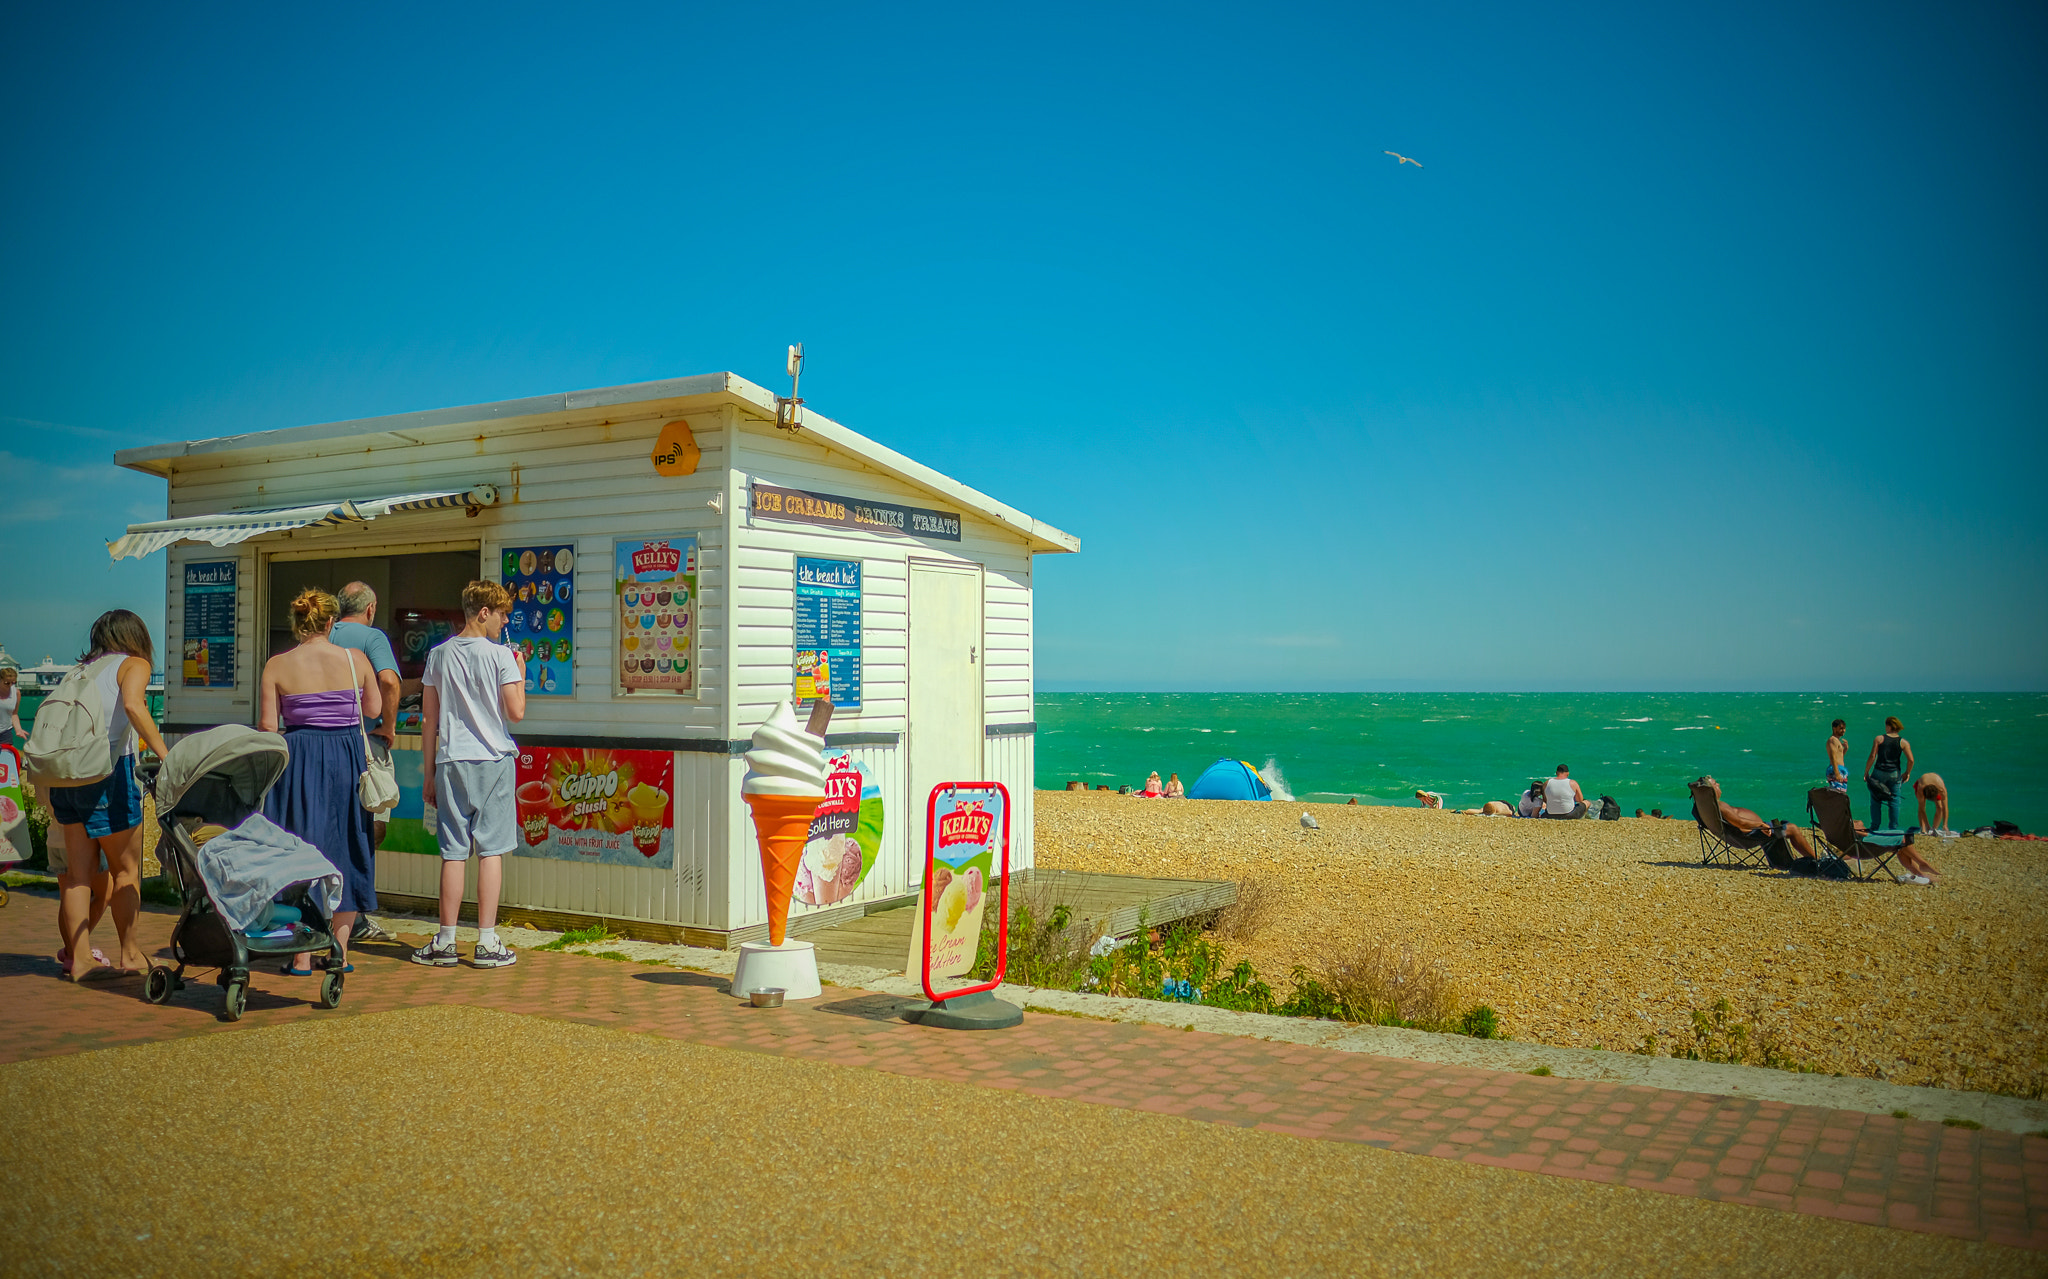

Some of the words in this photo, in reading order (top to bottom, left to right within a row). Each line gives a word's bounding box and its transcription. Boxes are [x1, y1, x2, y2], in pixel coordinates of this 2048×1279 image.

[655, 454, 675, 466] IPS
[756, 492, 782, 512] ICE
[785, 495, 846, 521] CREAMS
[855, 506, 905, 528] DRINKS
[912, 514, 959, 534] TREATS
[634, 551, 678, 566] KELLY'S
[187, 570, 197, 582] the
[198, 568, 218, 582] beach
[220, 568, 232, 582] hut
[798, 565, 814, 582] the
[816, 567, 840, 584] beach
[842, 568, 856, 584] hut
[560, 770, 618, 802] Calippo
[525, 816, 548, 832] Calippo
[634, 824, 660, 838] Calippo
[808, 816, 827, 837] Sold
[829, 815, 850, 830] Here
[942, 816, 990, 838] KELLY'S
[558, 836, 572, 846] MADE
[575, 838, 587, 847] WITH
[589, 838, 603, 848] FRUIT
[605, 839, 620, 849] JUICE
[939, 934, 966, 952] Cream
[930, 954, 944, 970] old
[942, 950, 962, 968] Here
